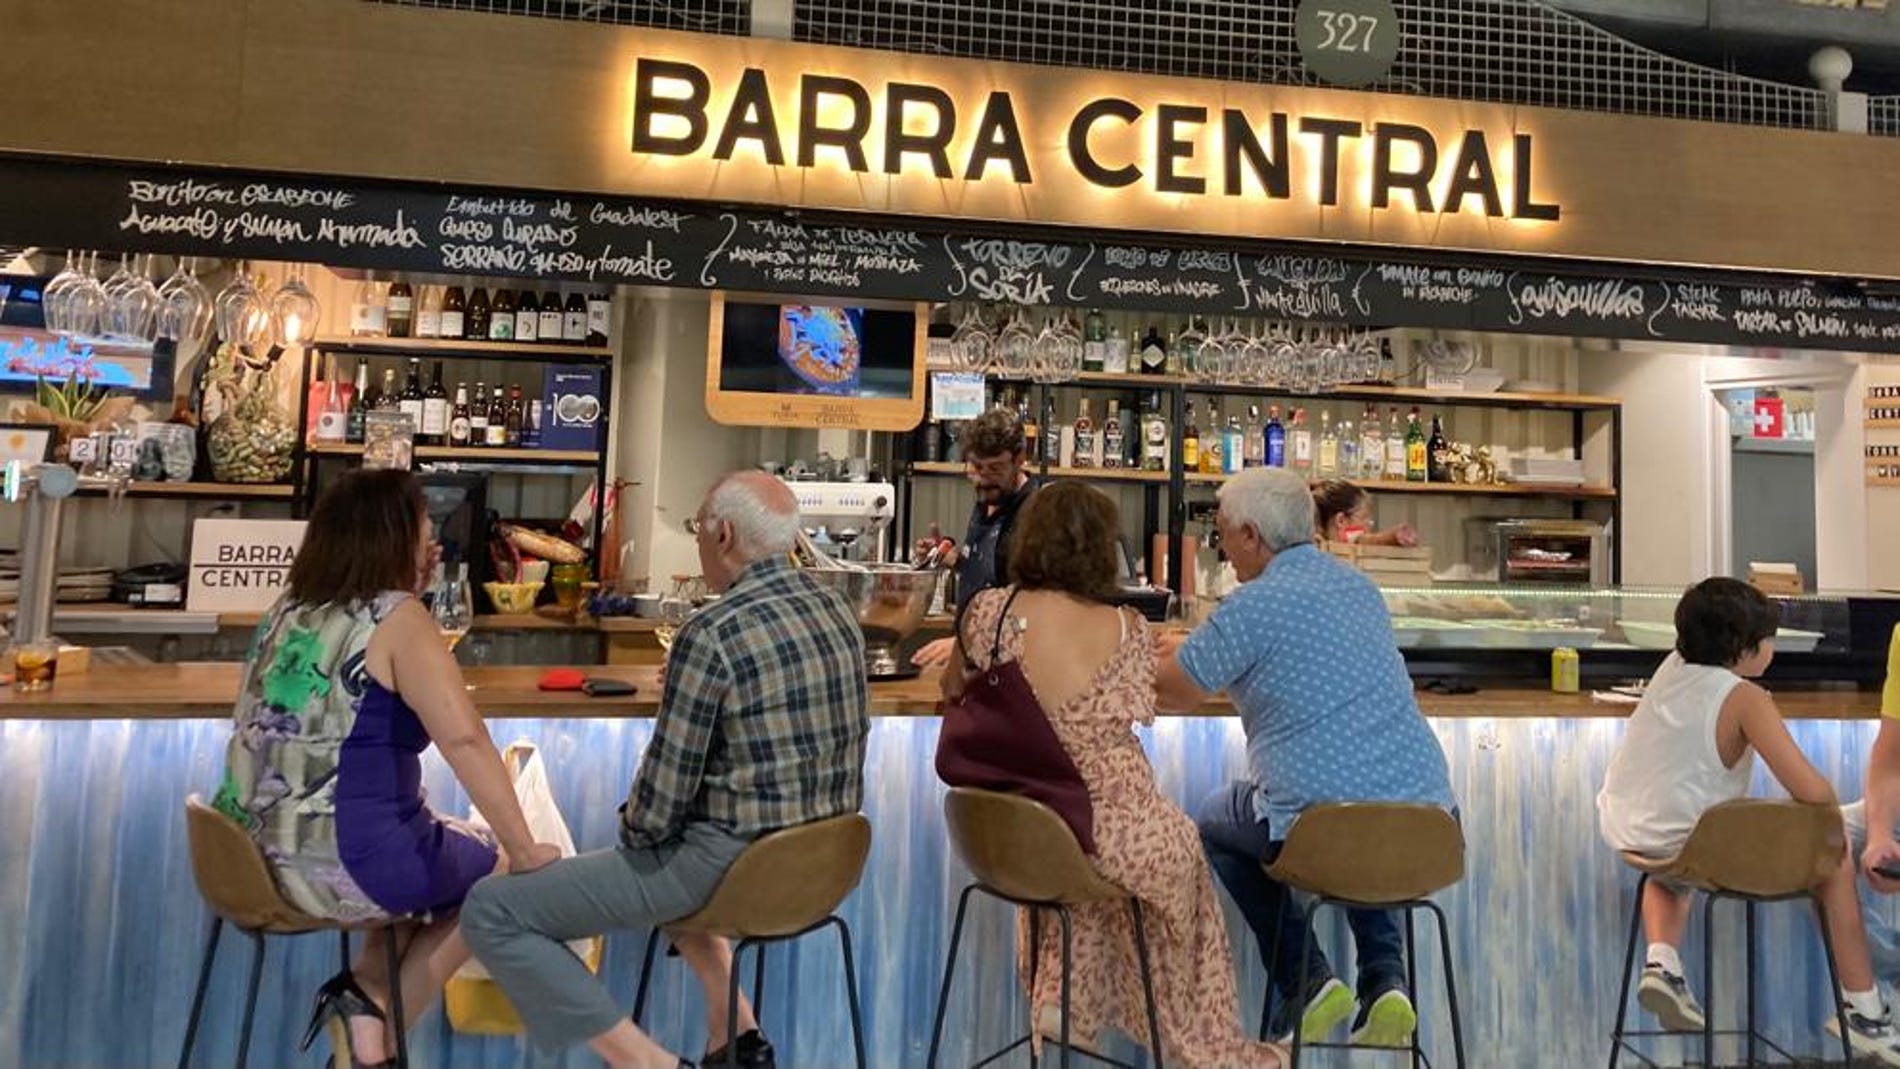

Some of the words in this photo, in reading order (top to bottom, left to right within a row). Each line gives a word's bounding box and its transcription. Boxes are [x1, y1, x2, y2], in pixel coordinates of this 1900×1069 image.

[1316, 10, 1379, 53] 327
[631, 57, 1033, 184] BARRA
[1067, 97, 1561, 221] CENTRAL
[76, 440, 90, 458] 2
[218, 544, 296, 563] BARRA
